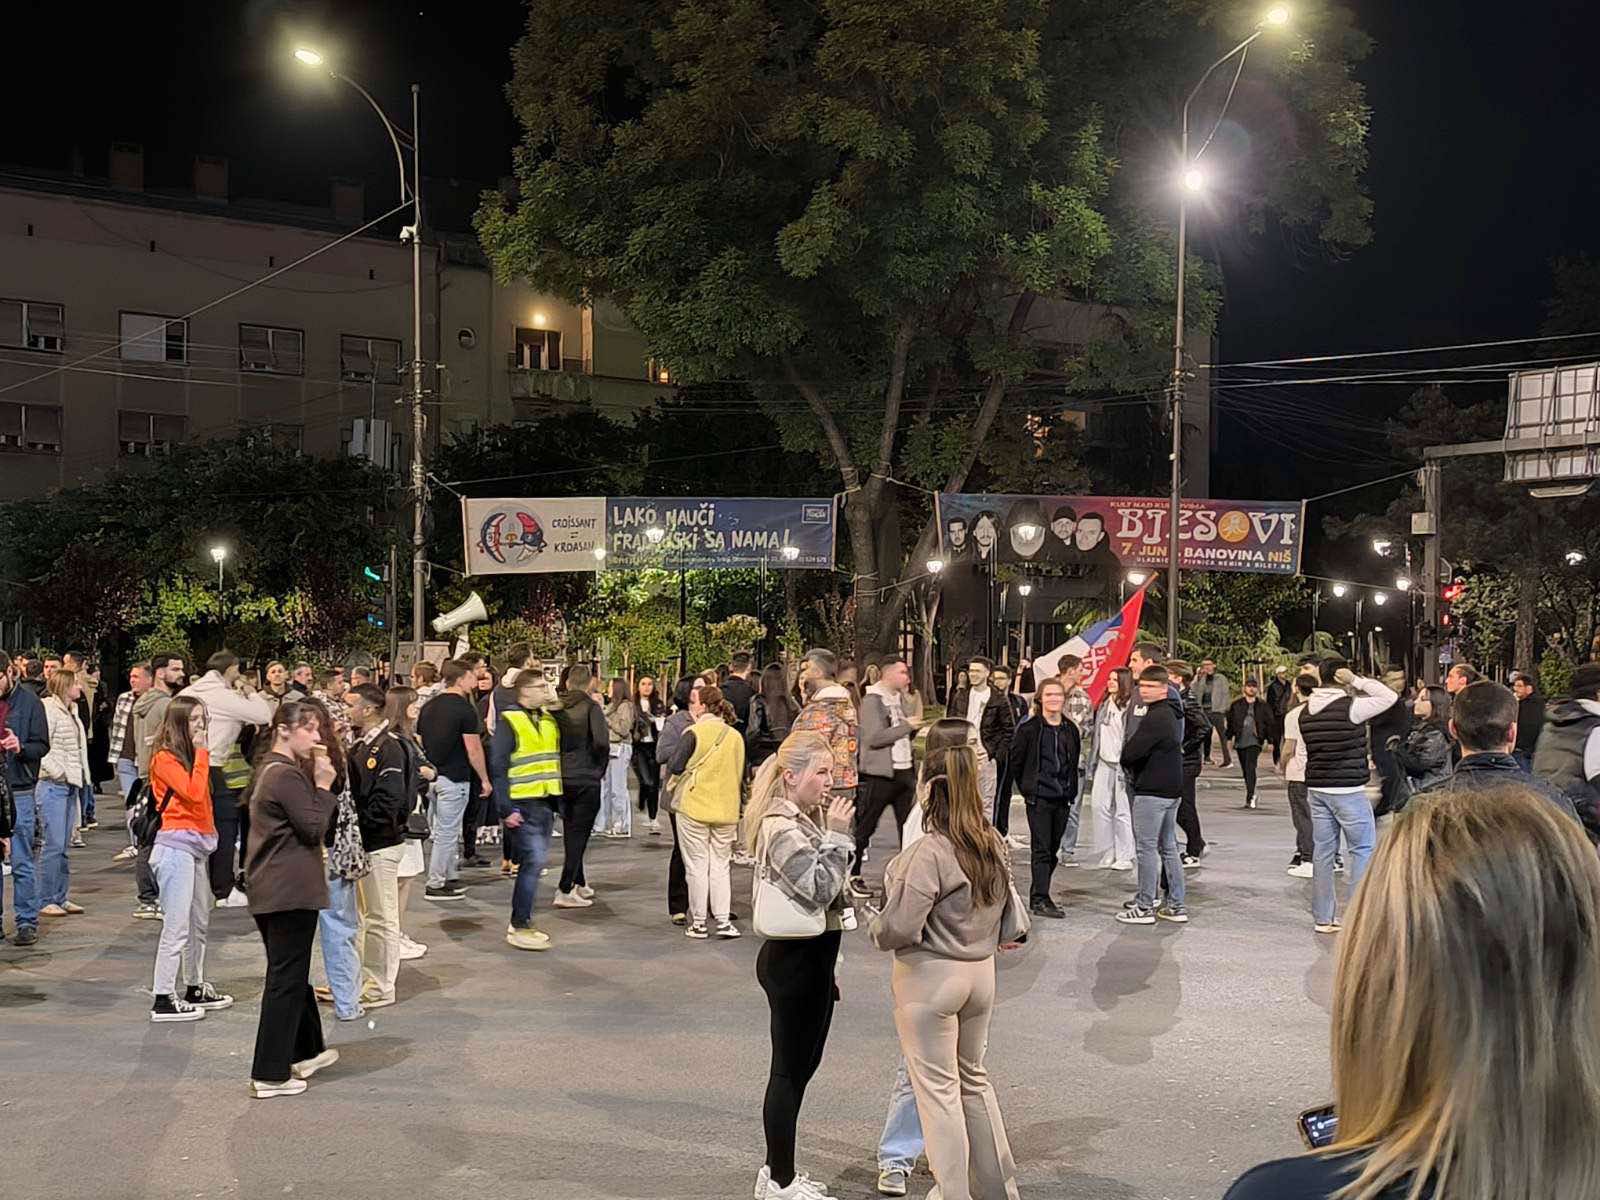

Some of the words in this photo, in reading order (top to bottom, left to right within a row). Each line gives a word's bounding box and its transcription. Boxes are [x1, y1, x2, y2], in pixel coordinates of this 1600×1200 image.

[613, 505, 657, 528] LAKO
[704, 530, 725, 551] SA
[1184, 547, 1265, 562] BANOVINA
[1268, 549, 1292, 563] NIŠ
